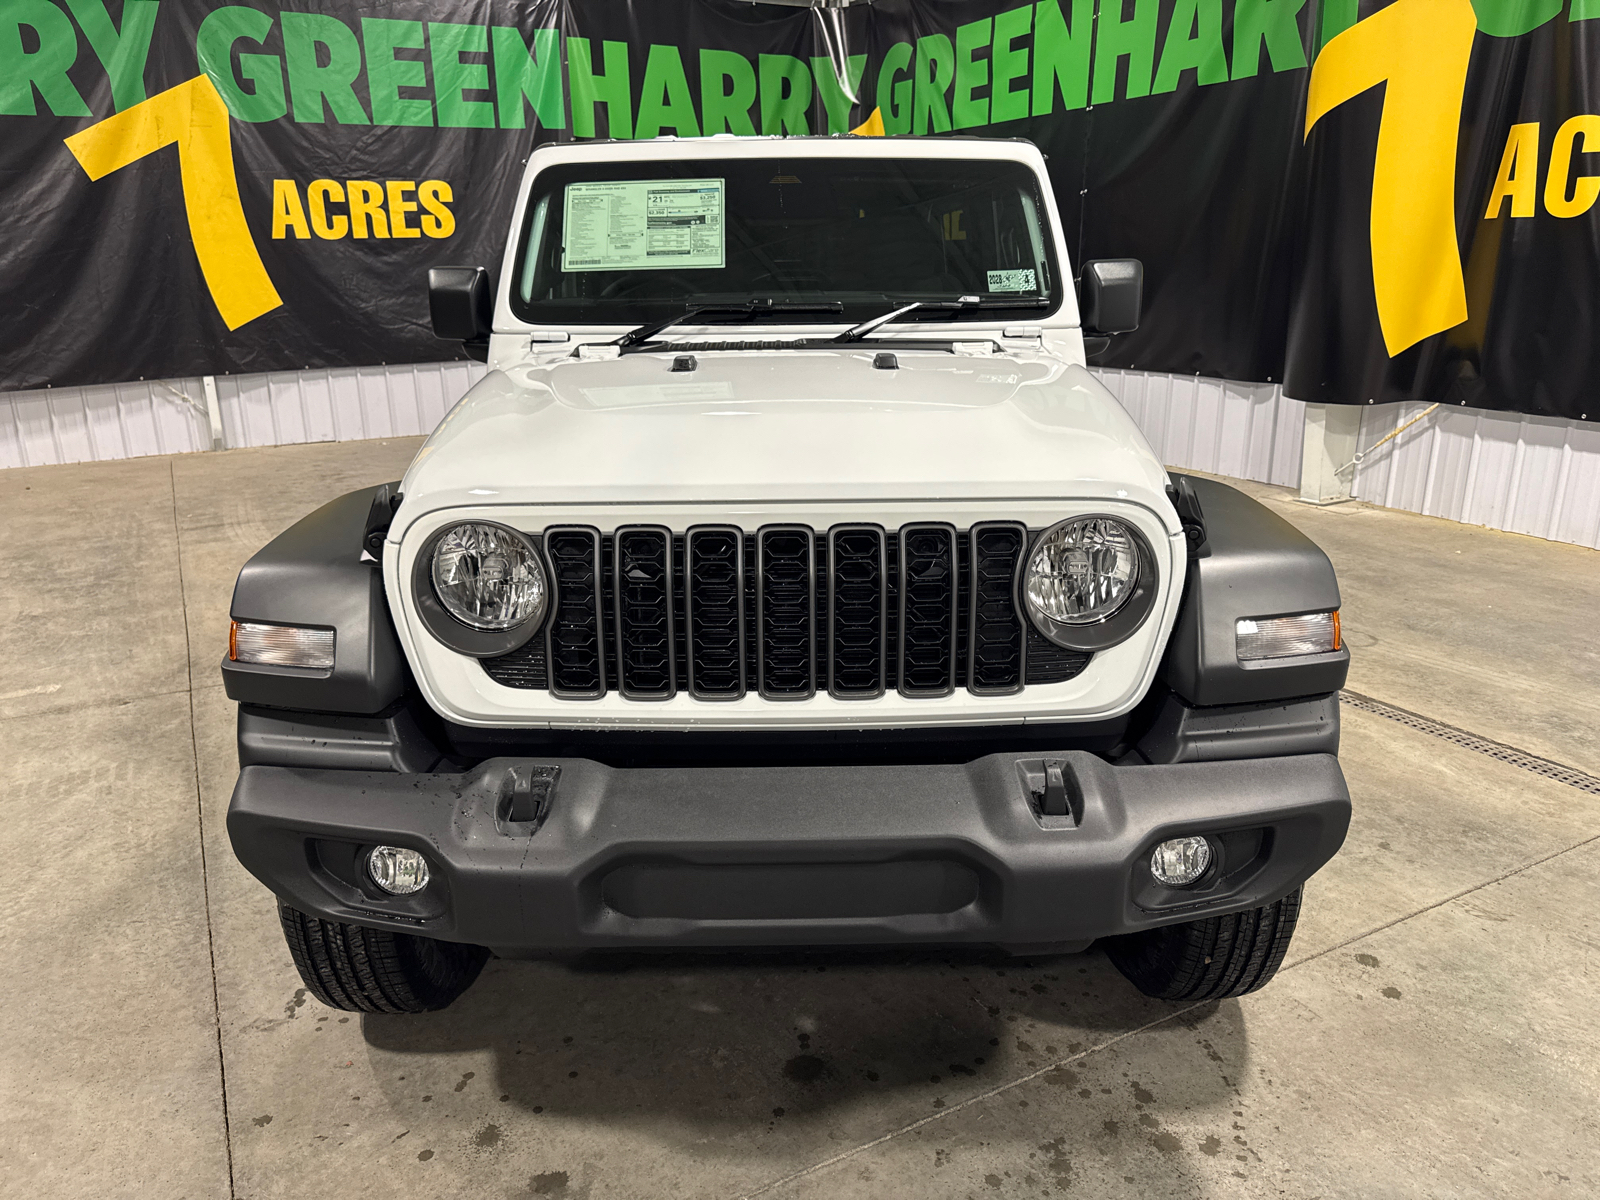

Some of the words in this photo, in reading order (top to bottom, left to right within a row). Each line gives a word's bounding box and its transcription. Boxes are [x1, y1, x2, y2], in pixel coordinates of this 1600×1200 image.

[197, 5, 566, 129] GREEN
[567, 37, 868, 138] HARRY
[876, 0, 1091, 137] GREEN
[63, 73, 283, 331] 7
[272, 178, 456, 240] ACRES
[1304, 0, 1477, 358] 7
